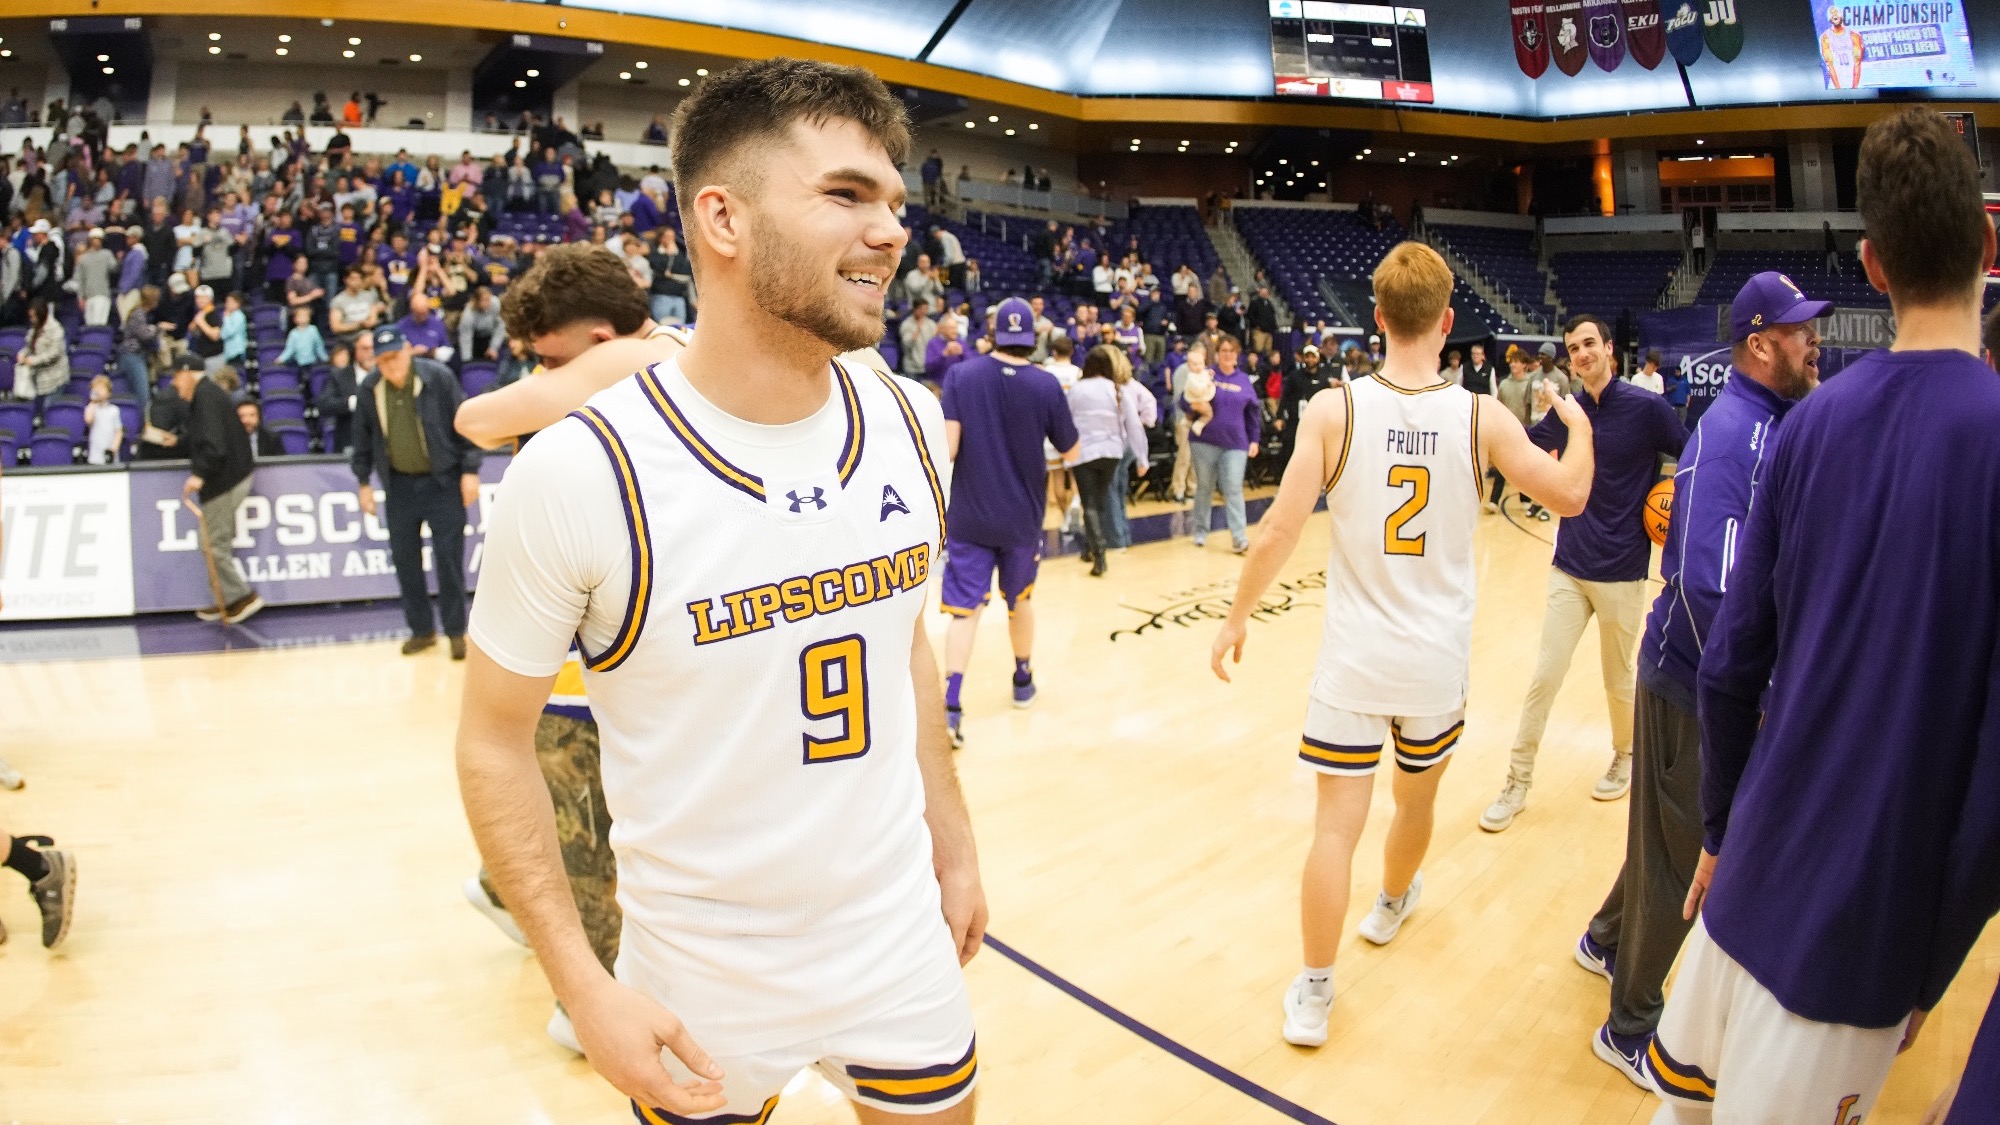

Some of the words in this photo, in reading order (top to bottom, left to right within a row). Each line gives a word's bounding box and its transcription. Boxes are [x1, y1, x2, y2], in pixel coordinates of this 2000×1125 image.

[1628, 14, 1659, 28] EKU
[1842, 3, 1953, 26] CHAMPIONSHIP
[1815, 313, 1883, 343] LANTIC
[1387, 428, 1438, 456] PRUITT
[1384, 464, 1431, 557] 2
[686, 541, 930, 647] LIPSCOMB
[799, 633, 871, 765] 9
